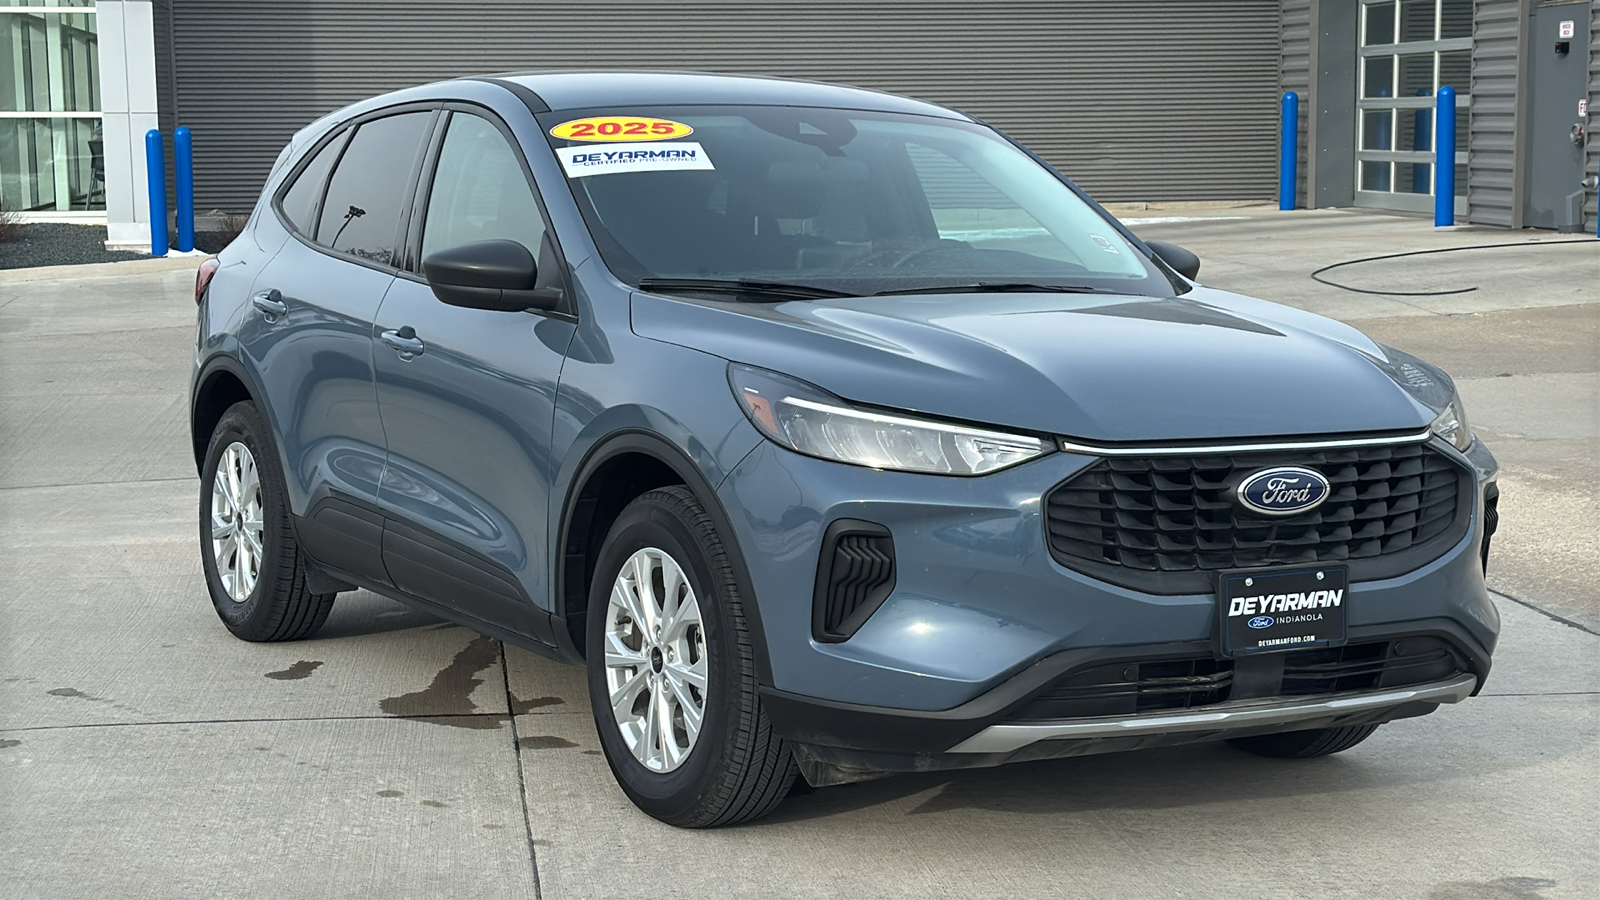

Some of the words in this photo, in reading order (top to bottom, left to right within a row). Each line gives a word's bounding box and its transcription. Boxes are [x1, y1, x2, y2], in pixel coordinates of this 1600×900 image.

[570, 122, 675, 137] 2025
[572, 150, 696, 164] DEYARMAN
[583, 159, 636, 167] CERTIFIED
[1262, 477, 1312, 504] Ford
[1228, 589, 1344, 617] DEYARMAN
[1276, 613, 1323, 624] INDIANOLA
[1258, 635, 1316, 647] DEYARMANFORD.COM
